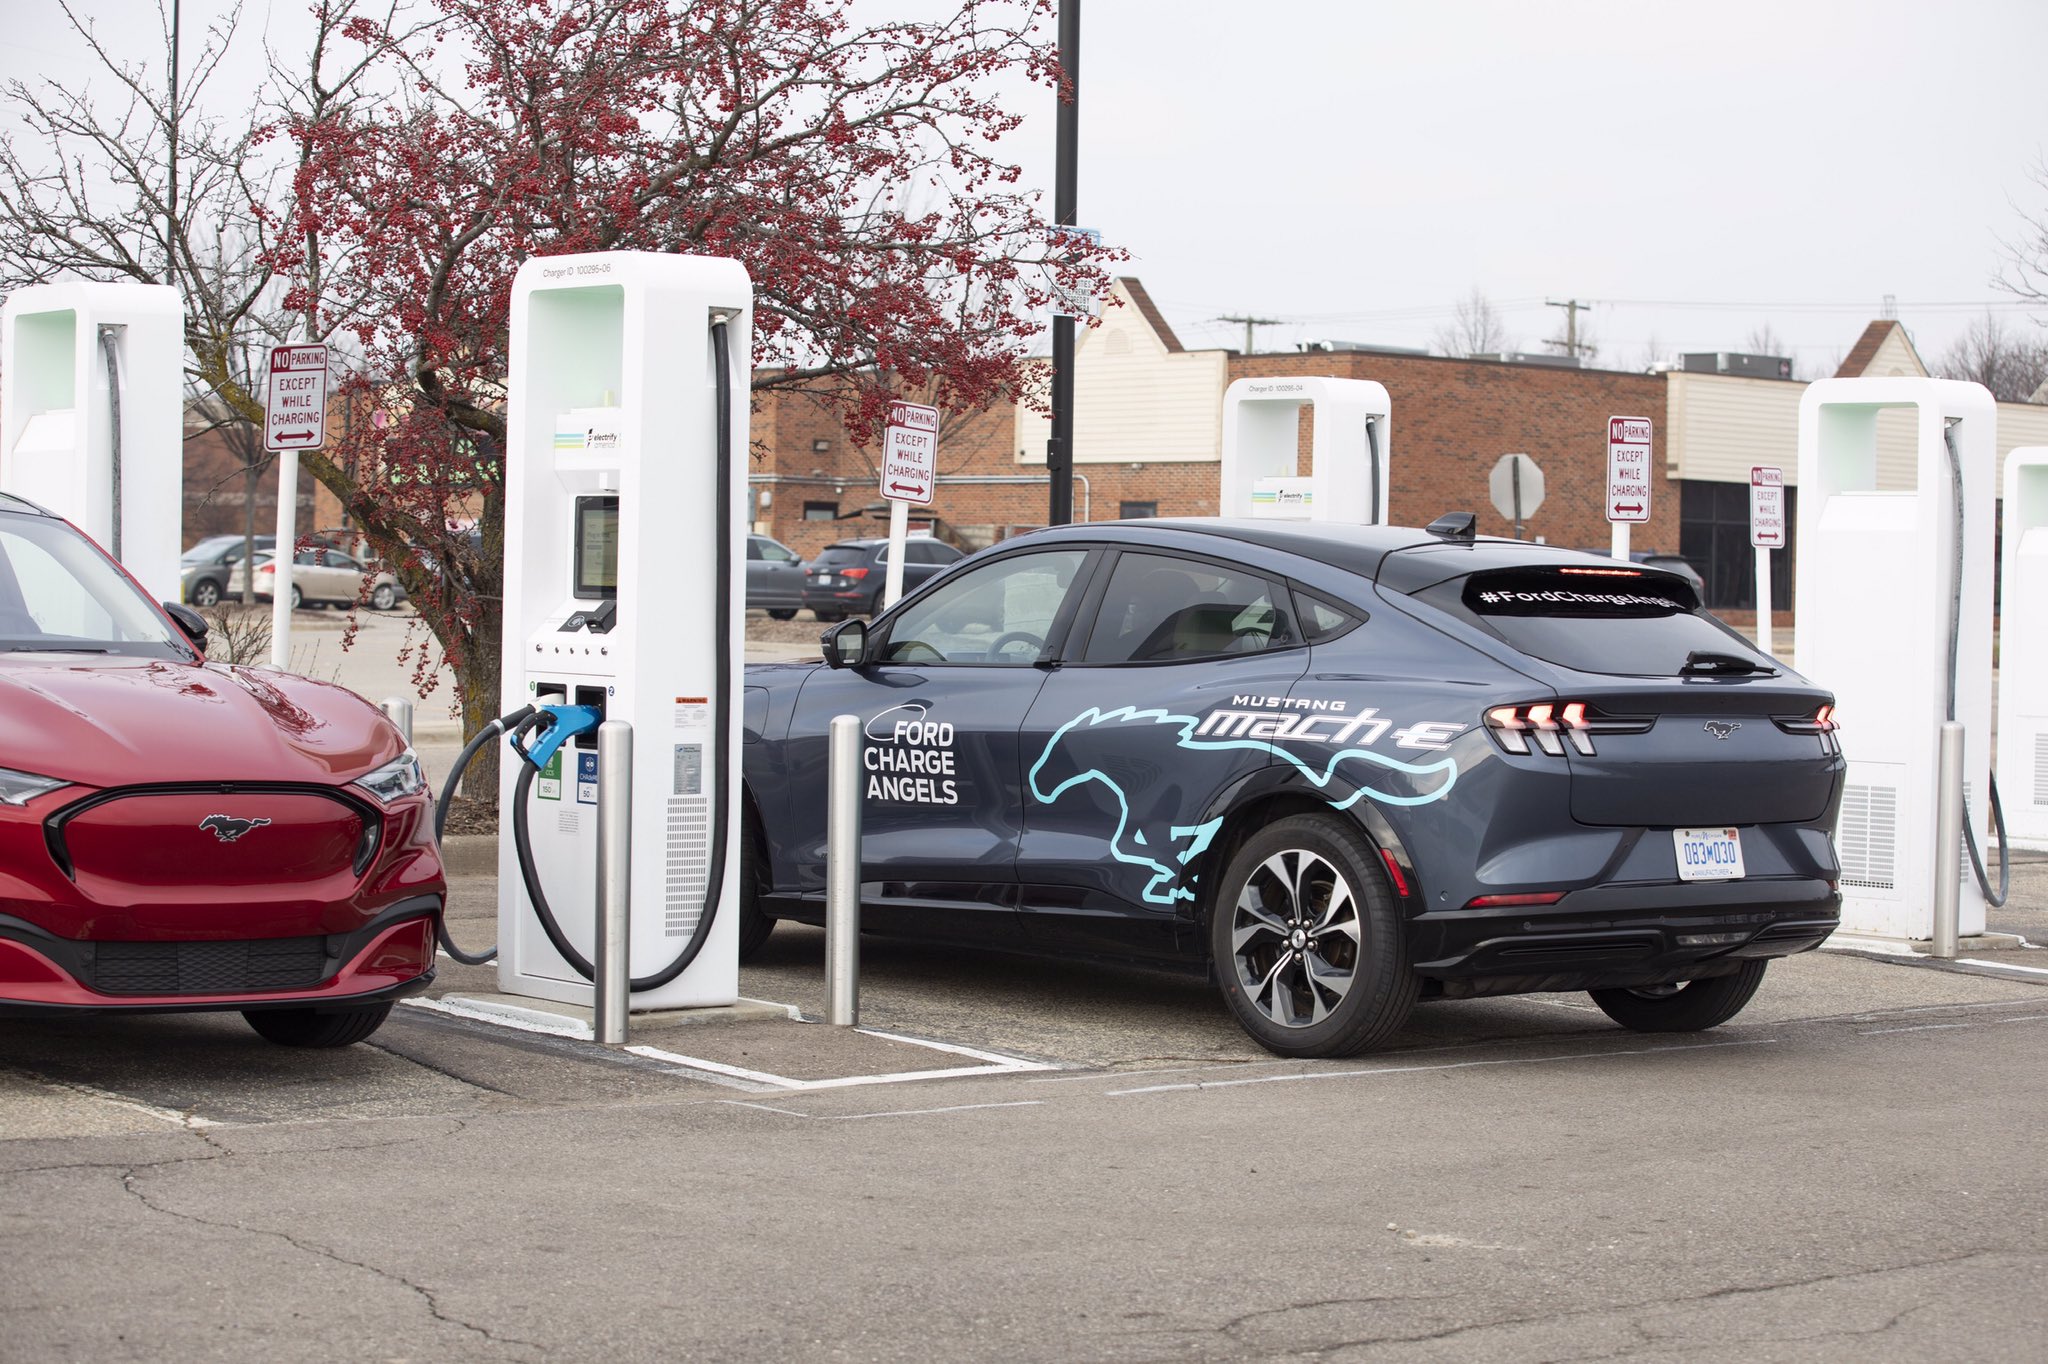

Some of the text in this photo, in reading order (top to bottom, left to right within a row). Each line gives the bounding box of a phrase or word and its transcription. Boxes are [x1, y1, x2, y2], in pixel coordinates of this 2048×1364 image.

[543, 269, 566, 279] Charger
[567, 267, 574, 276] ID
[274, 352, 324, 368] NO PARKING
[280, 377, 316, 391] EXCEPT
[282, 395, 312, 408] WHILE
[272, 411, 320, 426] CHARGING
[891, 407, 935, 427] NO PARKING
[1612, 422, 1649, 440] NO PARKING
[895, 432, 928, 448] EXCEPT
[897, 449, 923, 463] WHILE
[1616, 450, 1644, 462] EXCEPT
[887, 463, 930, 481] CHARGING
[1618, 468, 1641, 480] WHILE
[1753, 470, 1781, 482] NO PARKING
[1611, 484, 1647, 497] CHARGING
[1757, 491, 1777, 500] EXCEPT
[1759, 505, 1776, 514] WHILE
[1755, 518, 1781, 528] CHARGING
[1232, 695, 1347, 712] MUSTANG
[893, 720, 954, 747] FORD
[864, 746, 956, 775] CHARGE
[545, 769, 555, 777] CCS
[542, 785, 551, 794] 150
[583, 790, 590, 798] 50
[867, 774, 959, 805] ANGELS
[1684, 841, 1736, 865] 083M030
